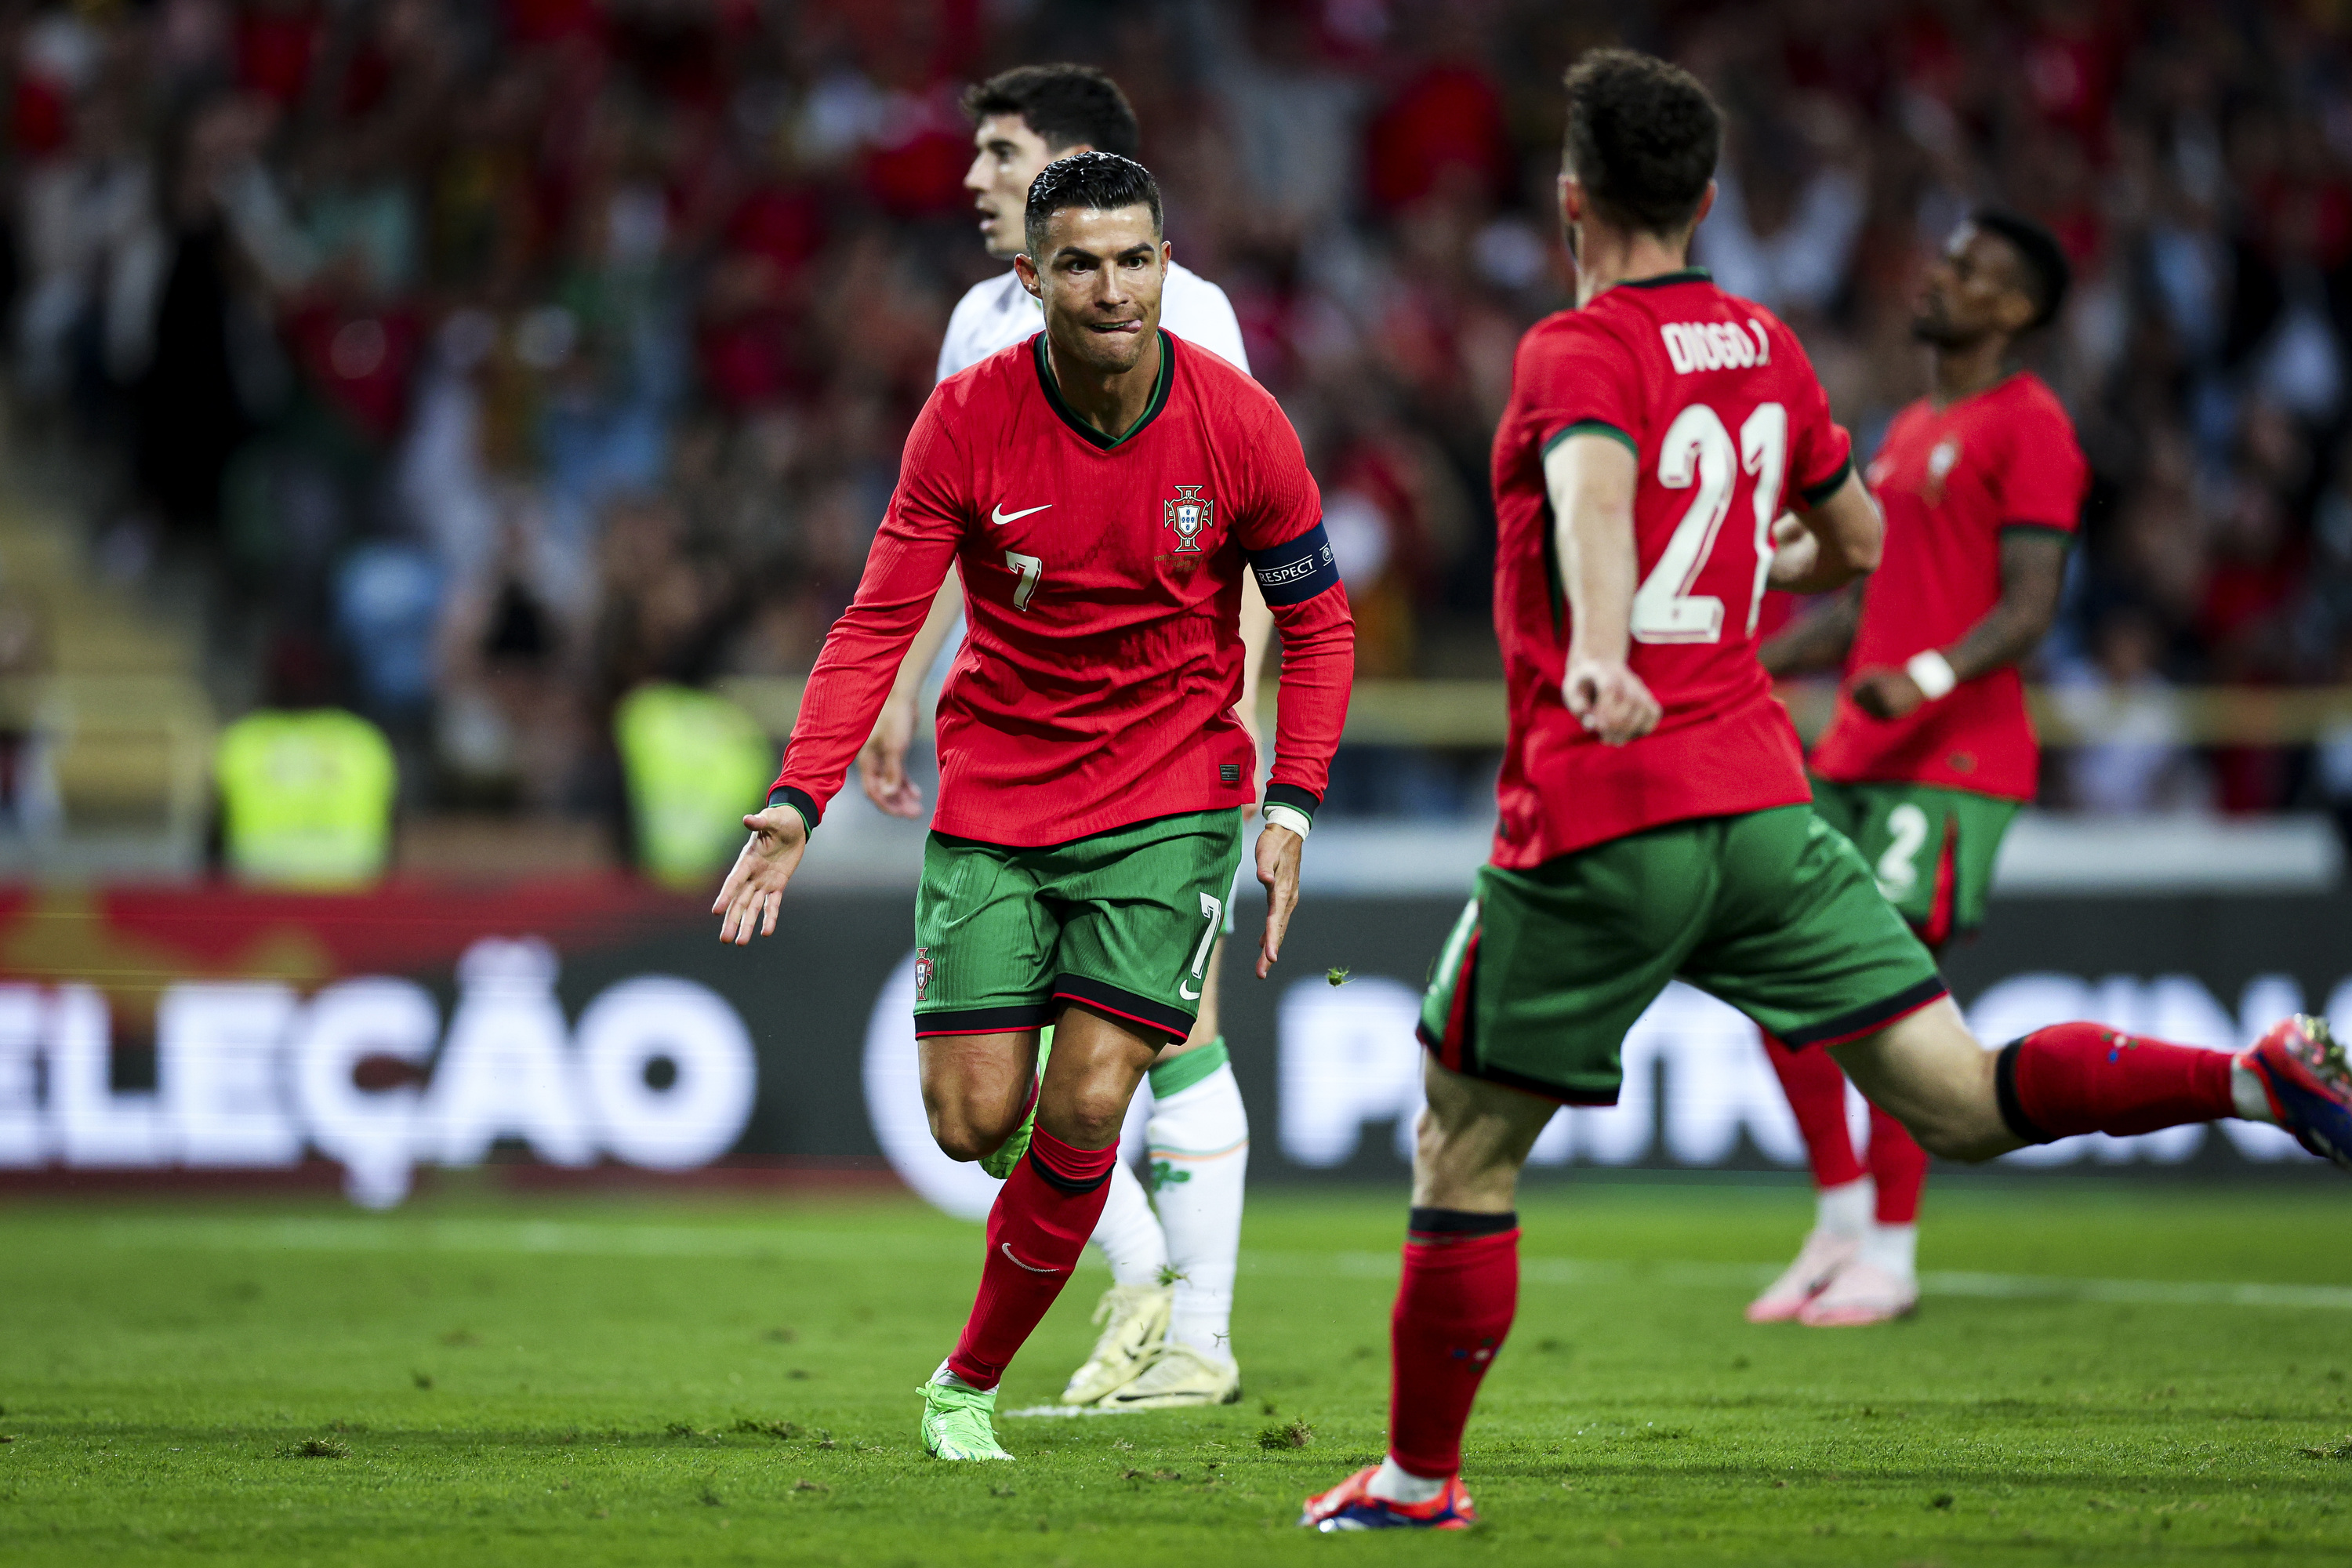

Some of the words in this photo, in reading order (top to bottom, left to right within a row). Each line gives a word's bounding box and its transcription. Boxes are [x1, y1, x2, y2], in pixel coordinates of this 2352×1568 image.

[1660, 321, 1756, 375] DIOGO
[1629, 402, 1788, 644] 21
[1005, 550, 1043, 612] 7
[1258, 558, 1314, 583] RESPECT
[1874, 801, 1929, 904] 2
[1191, 891, 1221, 980] 7
